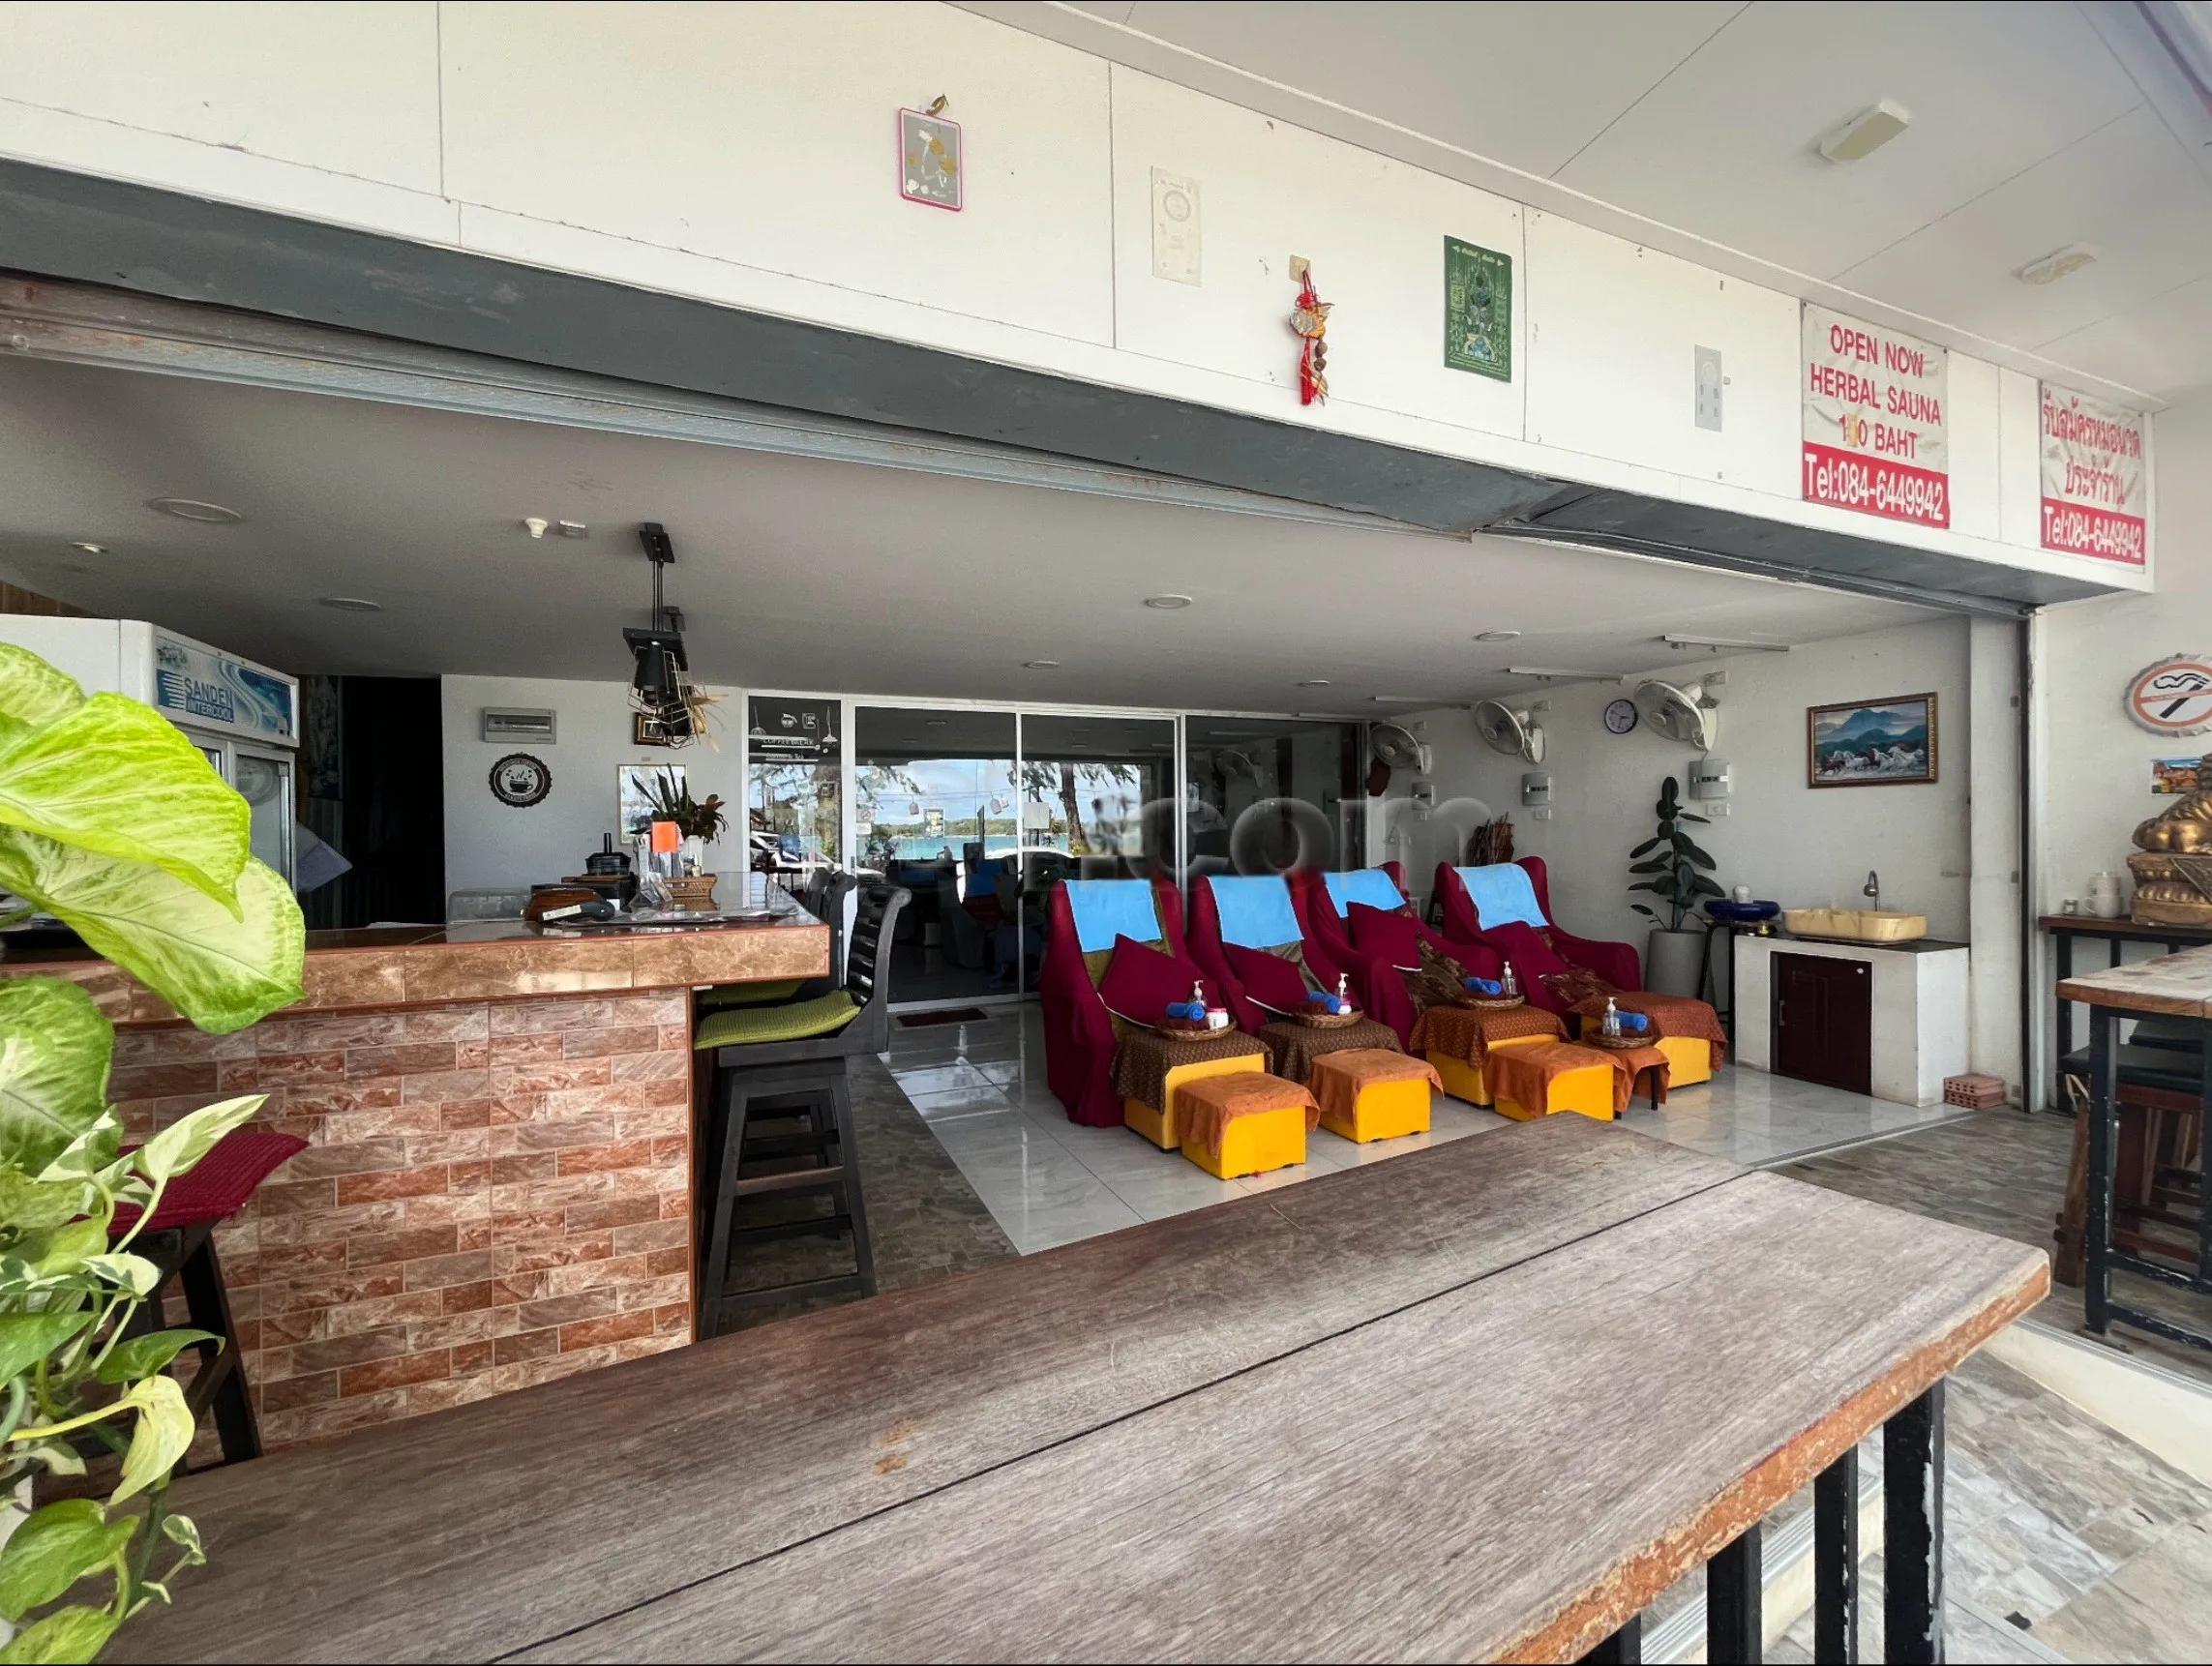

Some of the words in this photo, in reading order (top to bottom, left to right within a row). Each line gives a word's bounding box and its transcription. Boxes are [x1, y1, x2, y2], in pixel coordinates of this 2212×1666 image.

[1830, 324, 1878, 365] OPEN
[1885, 342, 1924, 378] NOW
[1810, 363, 1881, 409] HERBAL
[1887, 385, 1942, 427] SAUNA
[1838, 414, 1868, 447] 10
[1874, 423, 1919, 459] BAHT
[1805, 453, 1944, 521] Tel:084-6449942
[184, 677, 234, 708] SANDEN
[187, 698, 234, 722] INTERCOOL
